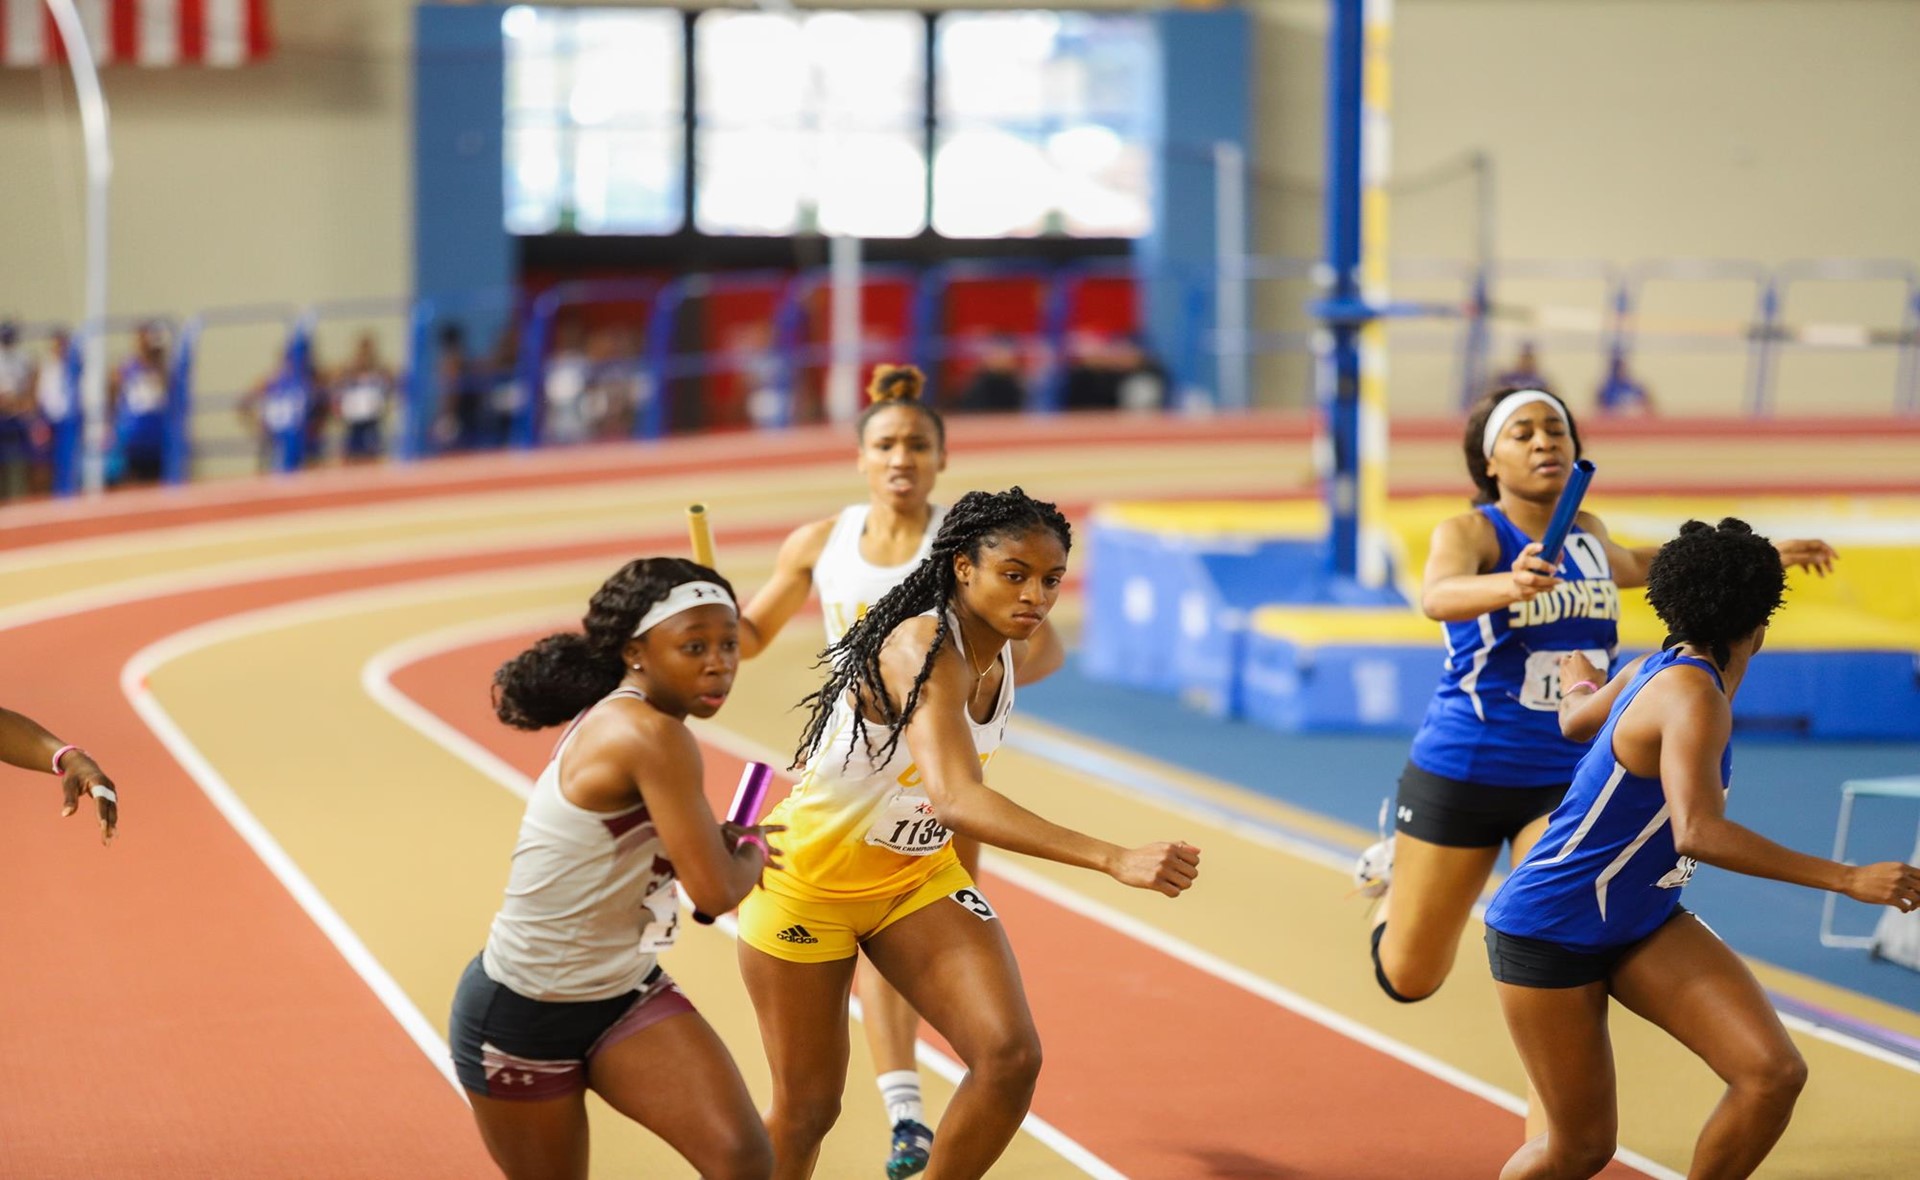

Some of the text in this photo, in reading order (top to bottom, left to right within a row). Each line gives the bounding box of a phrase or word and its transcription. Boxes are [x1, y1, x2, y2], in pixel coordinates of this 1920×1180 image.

[1577, 537, 1603, 574] 1
[889, 817, 947, 845] 1134
[955, 889, 993, 916] 3
[776, 933, 819, 944] adidas
